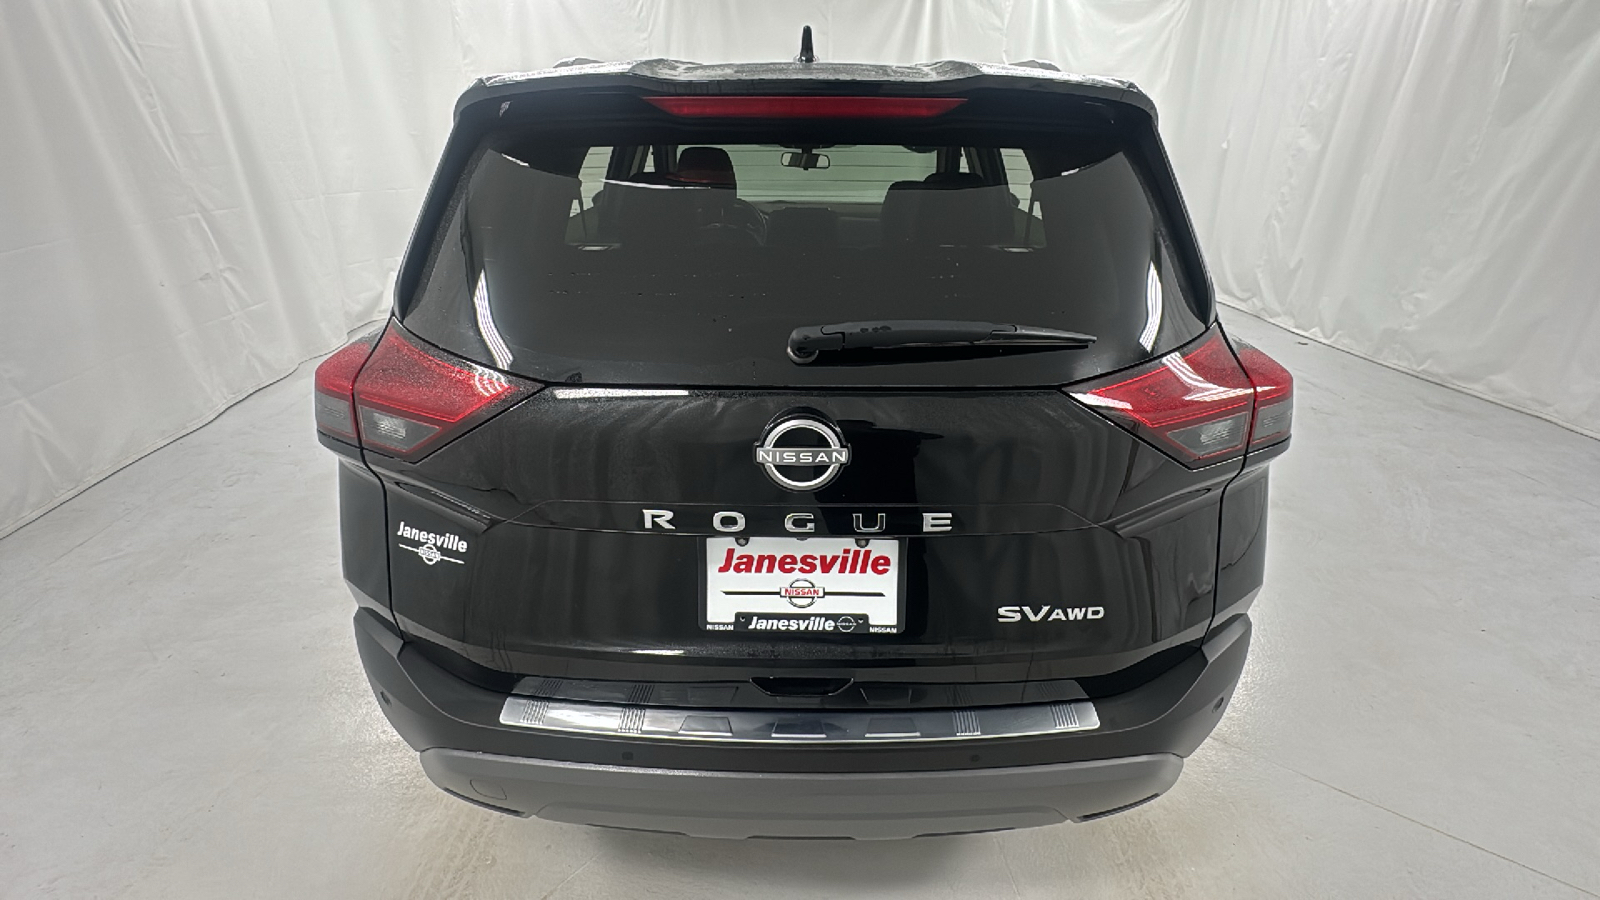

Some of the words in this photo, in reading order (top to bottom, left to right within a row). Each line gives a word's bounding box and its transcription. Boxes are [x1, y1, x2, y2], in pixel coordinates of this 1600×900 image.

[759, 450, 846, 463] NISSAN
[642, 509, 953, 533] ROGUE
[397, 521, 468, 552] Janesville
[718, 548, 891, 575] Janesville
[784, 588, 820, 596] NISSAN
[748, 616, 835, 631] Janesville
